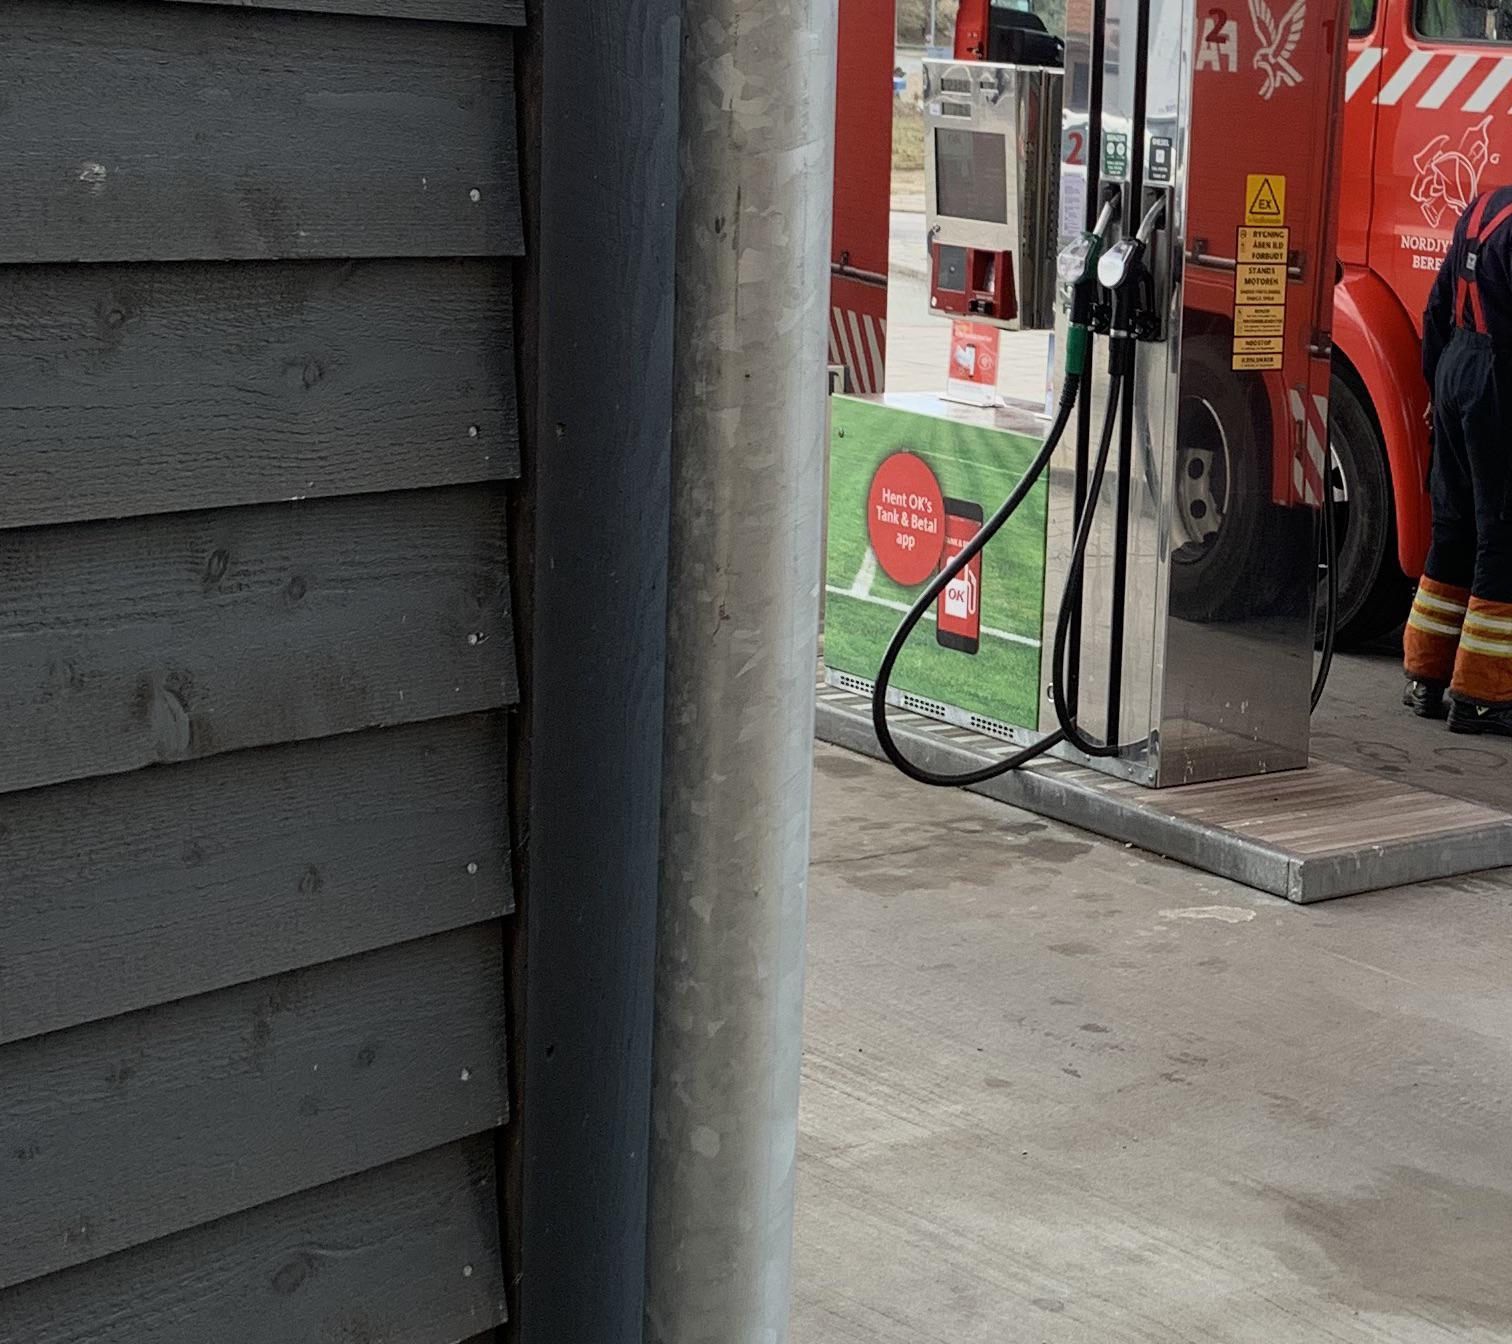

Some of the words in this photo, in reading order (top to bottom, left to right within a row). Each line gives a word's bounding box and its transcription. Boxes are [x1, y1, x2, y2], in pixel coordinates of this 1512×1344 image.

[1205, 8, 1227, 44] 2
[1065, 131, 1084, 165] 2
[1258, 199, 1272, 210] EX
[1252, 230, 1284, 239] RYGNING
[1400, 235, 1453, 254] NORDJY
[1251, 252, 1284, 260] FORBUDT
[1412, 254, 1446, 271] BERE
[1248, 267, 1275, 275] STANDS
[1244, 278, 1279, 286] MOTOREN
[882, 488, 907, 506] Hent
[909, 493, 933, 513] OK’s
[876, 506, 899, 526] Tank
[901, 513, 909, 528] &
[911, 515, 938, 534] Betal
[896, 532, 916, 551] app
[948, 587, 965, 603] OK
